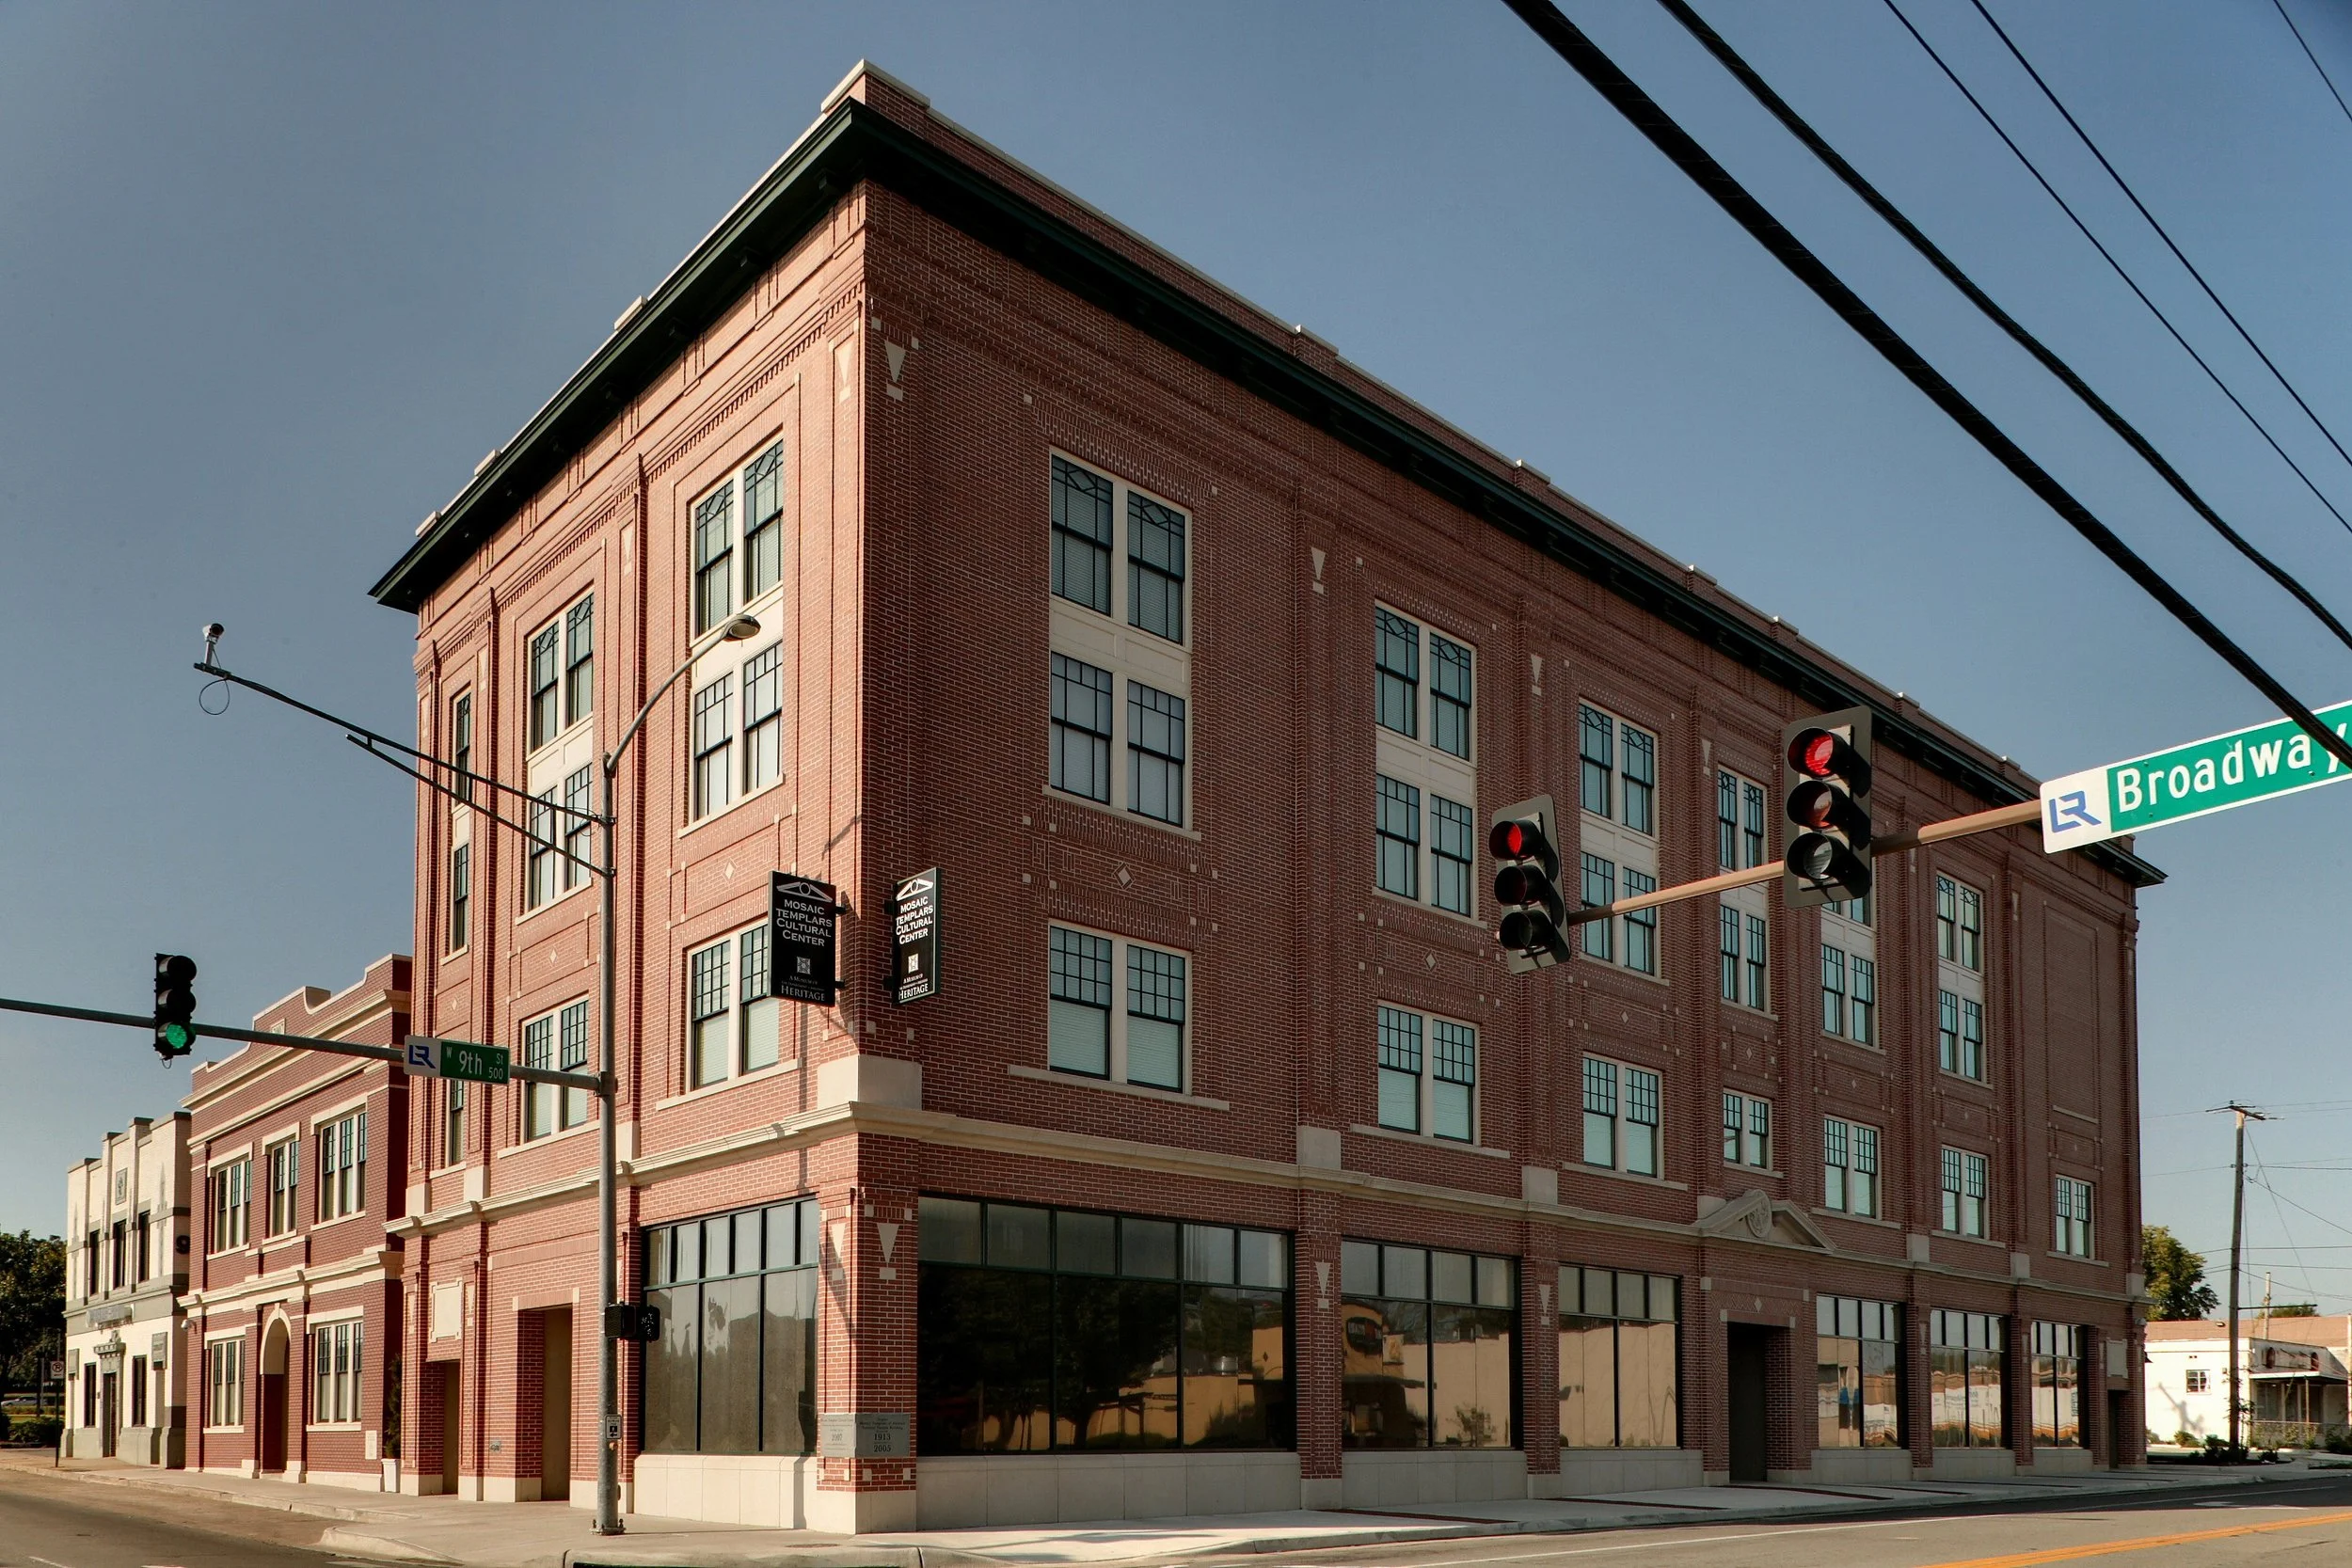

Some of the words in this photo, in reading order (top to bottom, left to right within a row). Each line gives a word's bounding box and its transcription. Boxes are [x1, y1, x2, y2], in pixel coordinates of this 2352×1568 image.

[784, 898, 825, 915] MOSAIC
[900, 896, 929, 913] MOSAIC
[776, 908, 833, 927] TEMPLARS
[896, 905, 933, 927] TEMPLARS
[776, 918, 832, 938] CULTURAL
[896, 916, 933, 936] CULTURAL
[783, 929, 825, 947] CENTER
[899, 927, 929, 944] CENTER
[781, 985, 825, 1002] HERITAGE
[898, 983, 929, 1000] HERITAGE
[446, 1046, 452, 1058] W
[459, 1050, 483, 1075] 9th
[496, 1053, 503, 1065] St
[488, 1067, 503, 1080] 500
[874, 1433, 891, 1441] 1913
[873, 1444, 892, 1453] 2005
